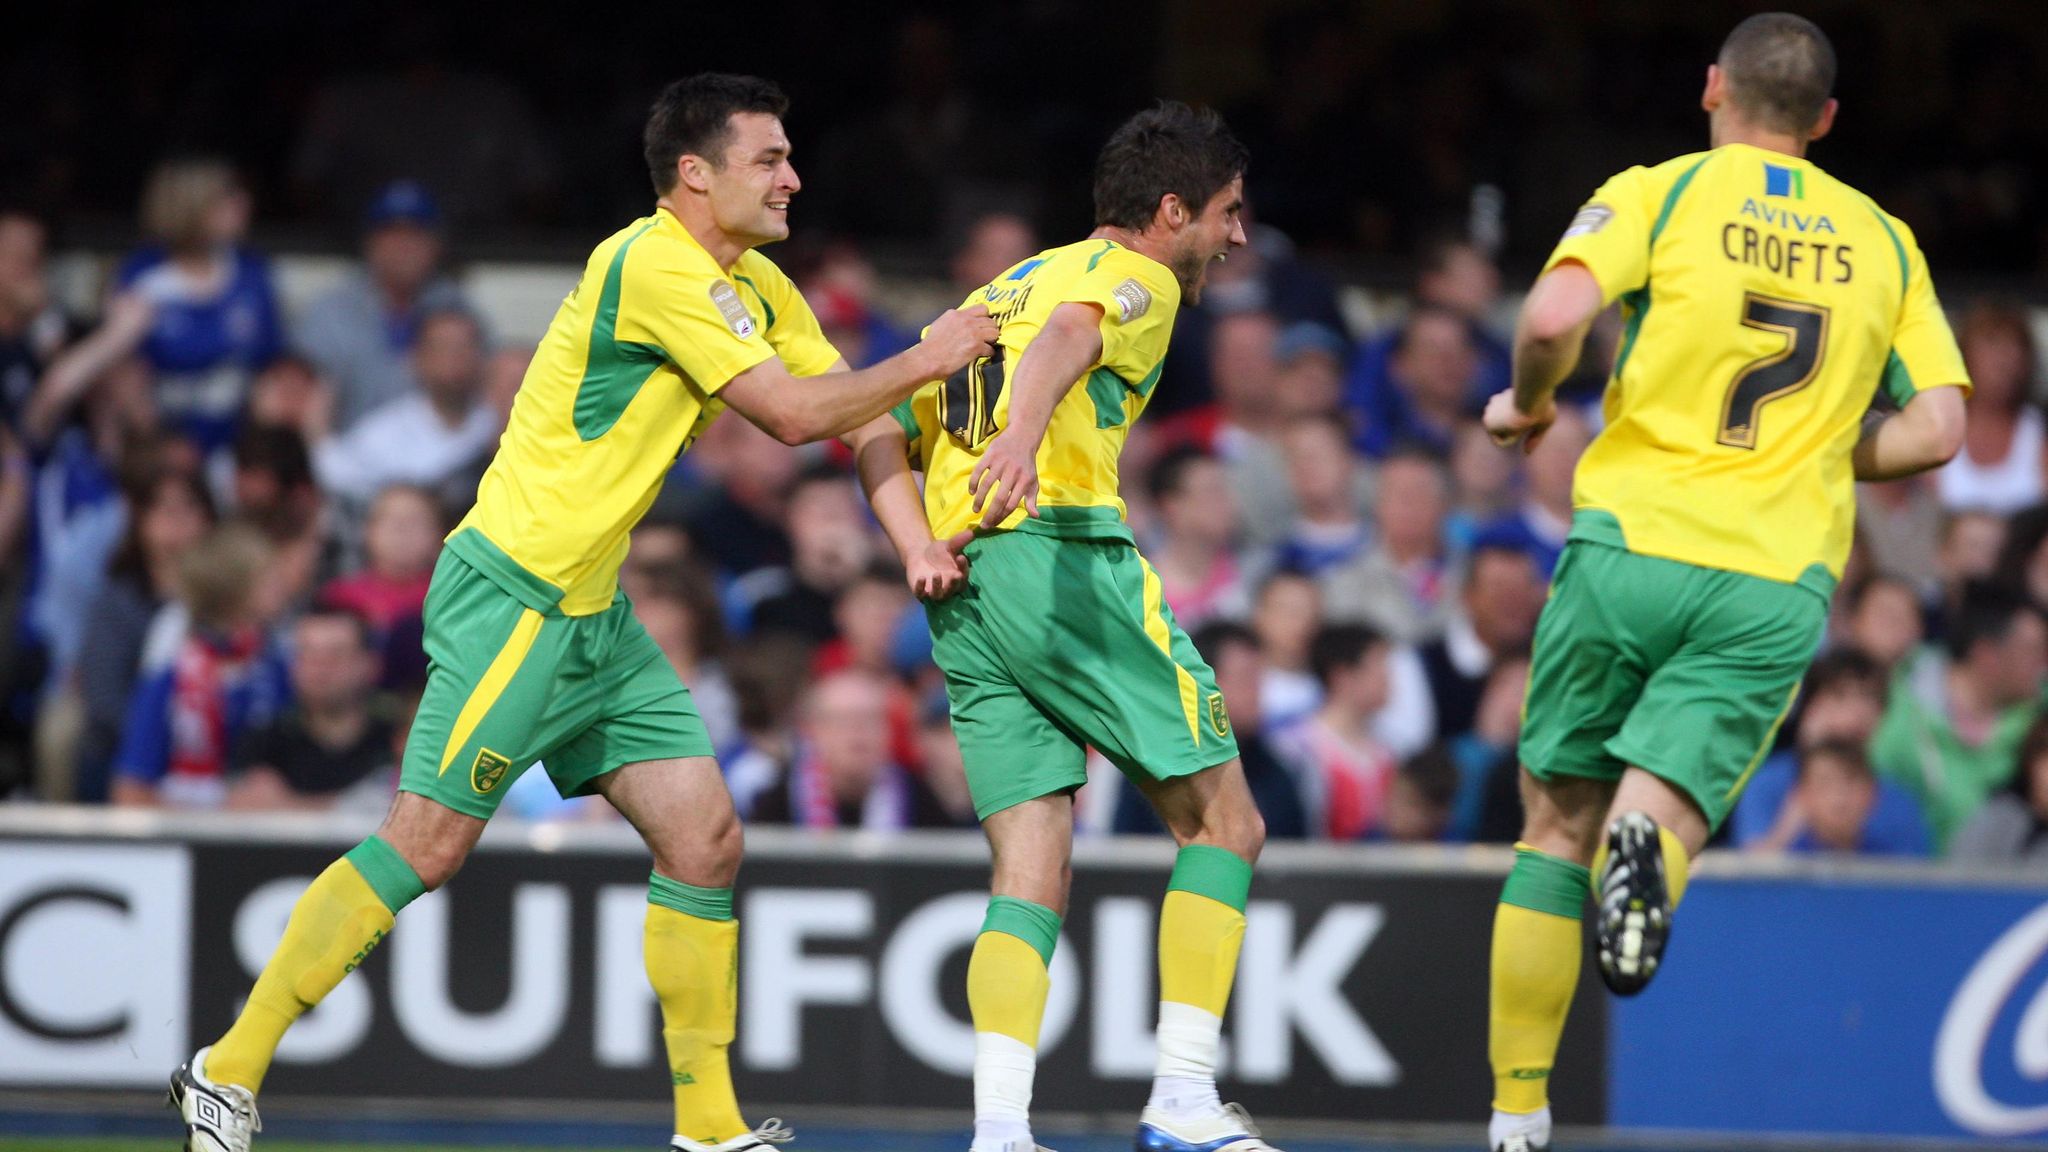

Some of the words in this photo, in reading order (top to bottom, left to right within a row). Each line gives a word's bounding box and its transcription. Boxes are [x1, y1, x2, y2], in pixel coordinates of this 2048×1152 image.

[1740, 198, 1837, 234] AVIVA
[1722, 222, 1853, 284] CROFTS
[1717, 290, 1831, 450] 7
